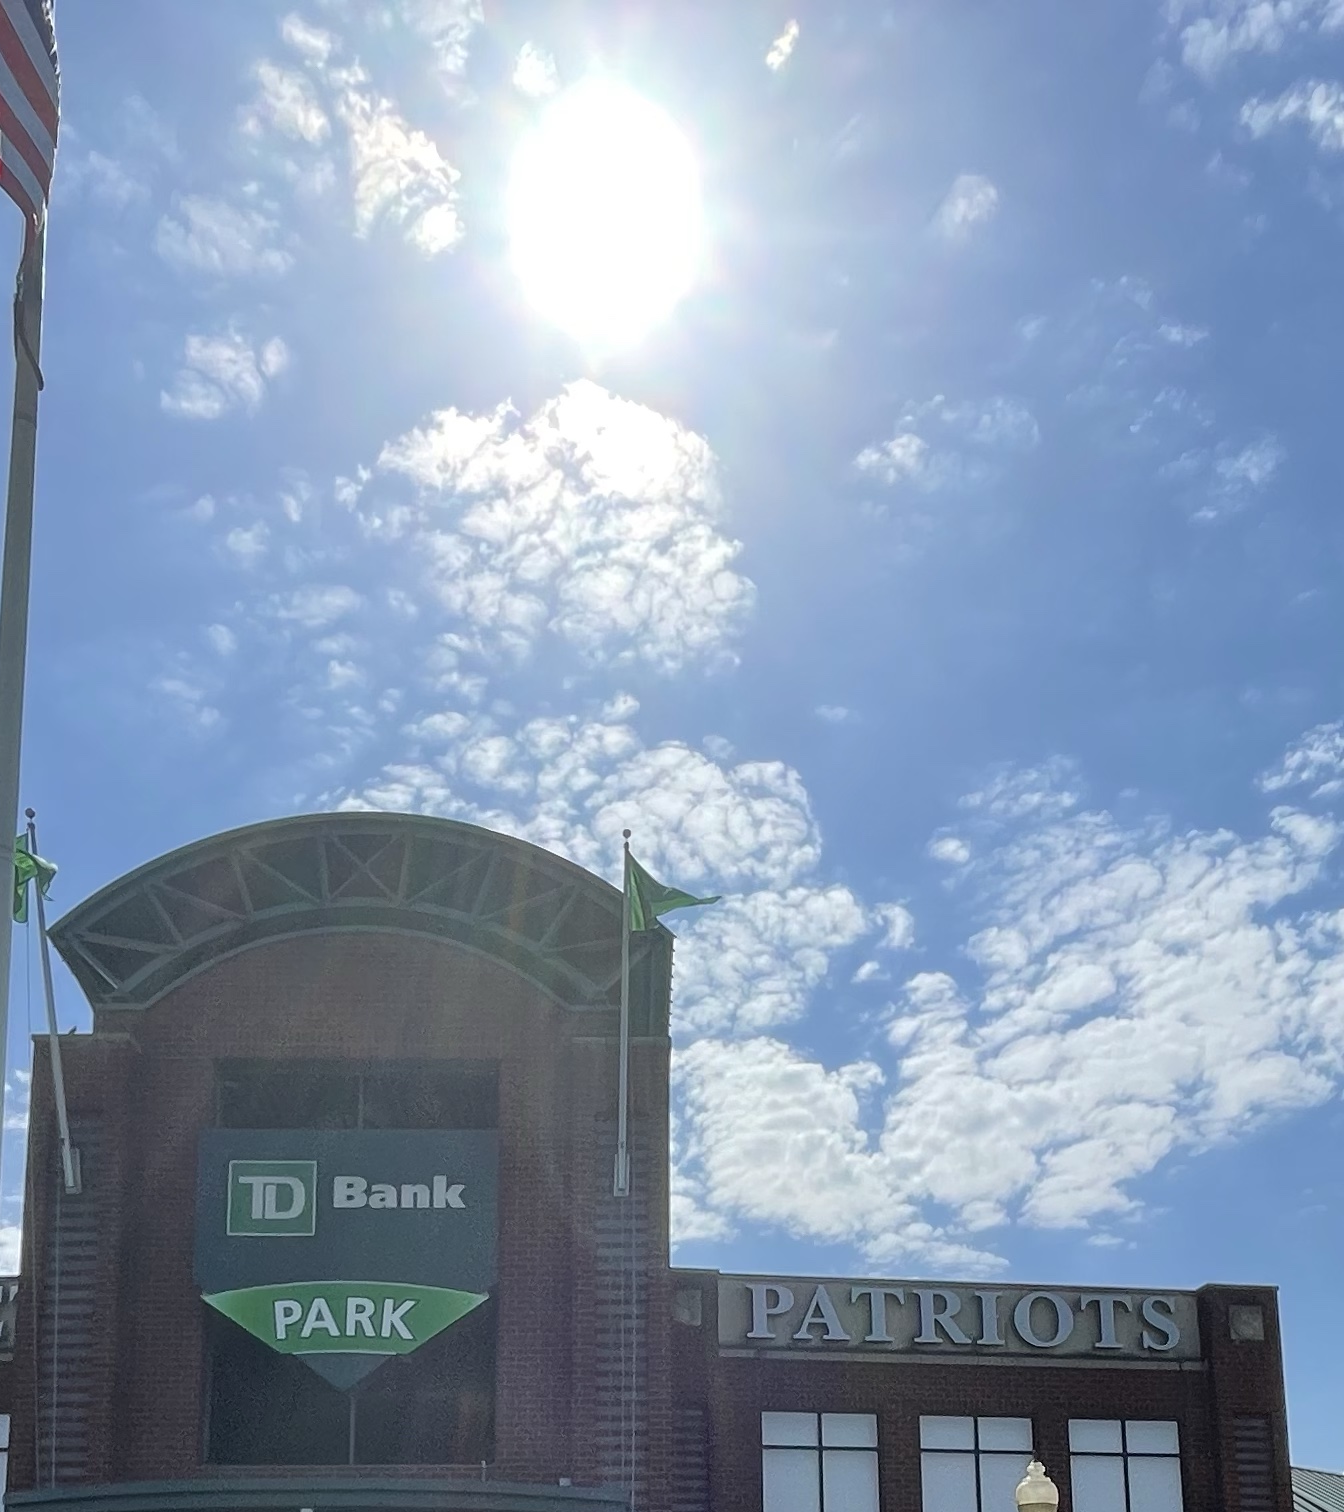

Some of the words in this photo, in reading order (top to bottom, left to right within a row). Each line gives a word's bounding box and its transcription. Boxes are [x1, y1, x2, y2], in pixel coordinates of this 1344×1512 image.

[238, 1176, 306, 1219] TD
[333, 1174, 467, 1209] Bank
[273, 1297, 418, 1341] PARK
[746, 1283, 1181, 1351] PATRIOTS
